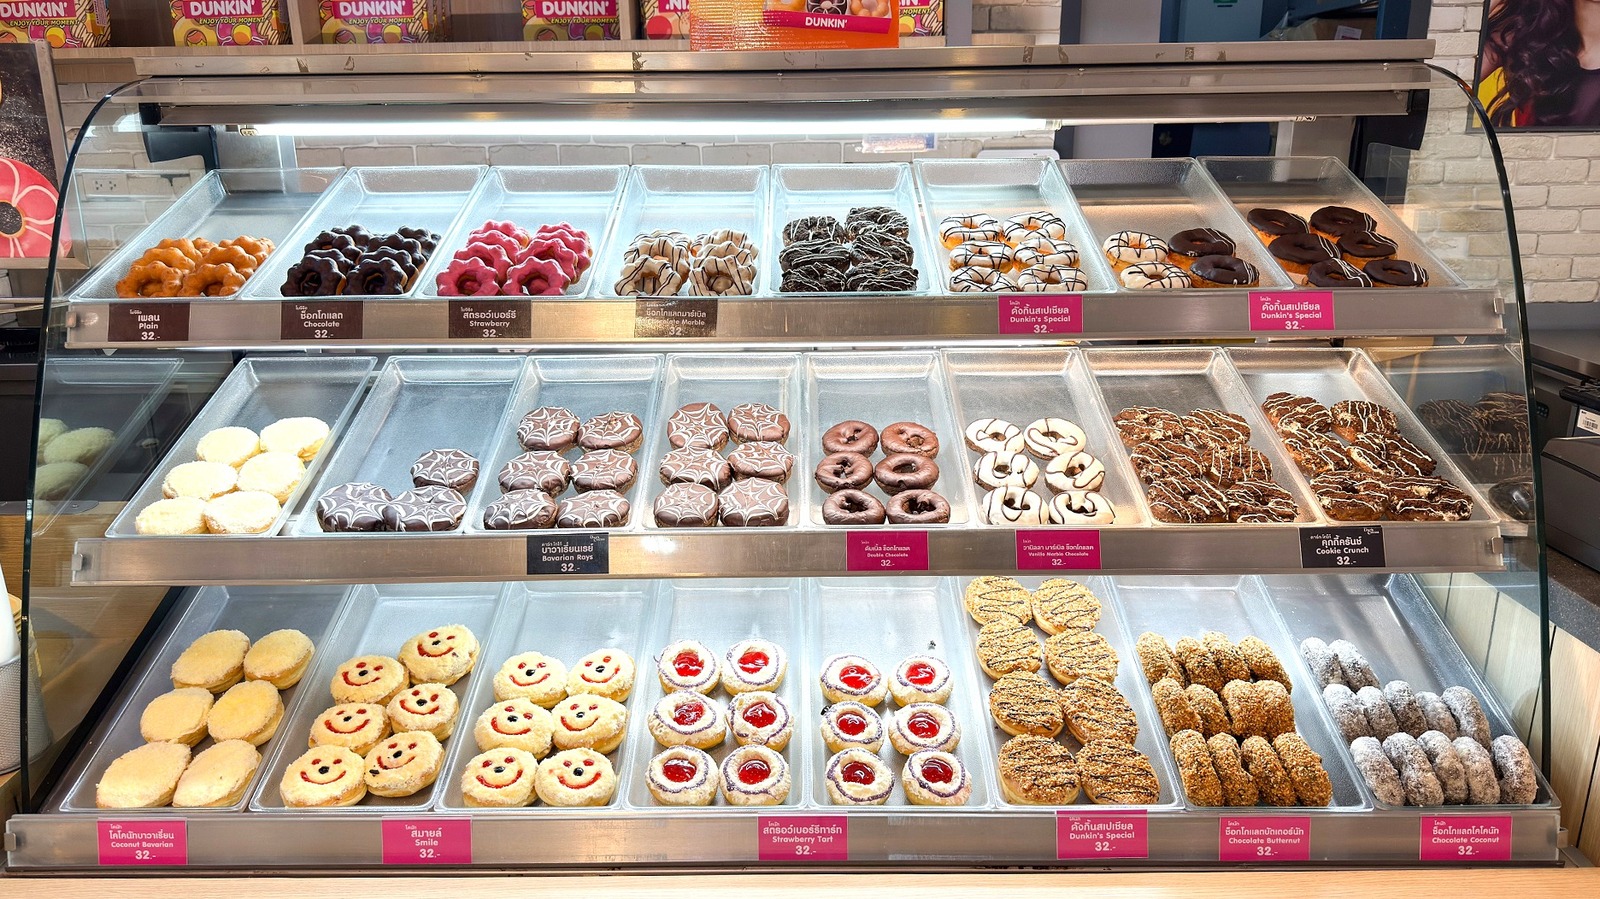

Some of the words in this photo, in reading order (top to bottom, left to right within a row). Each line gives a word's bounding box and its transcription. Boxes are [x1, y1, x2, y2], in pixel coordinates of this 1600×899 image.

[0, 2, 68, 18] DUNKIN'
[190, 0, 255, 15] DUNKIN'
[340, 0, 405, 16] DUNKIN'
[542, 1, 609, 16] DUNKIN'
[805, 16, 847, 29] DUNKIN'
[138, 314, 160, 322] เพลน
[1043, 315, 1071, 323] Special
[1295, 312, 1322, 320] Special
[1343, 546, 1369, 554] Crunch
[542, 554, 574, 562] Bavarian
[411, 828, 442, 838] สมายล์
[1069, 832, 1104, 840] Dunkin's
[1106, 832, 1135, 840] Special
[415, 838, 439, 846] Smile
[772, 836, 815, 844] Strawberry
